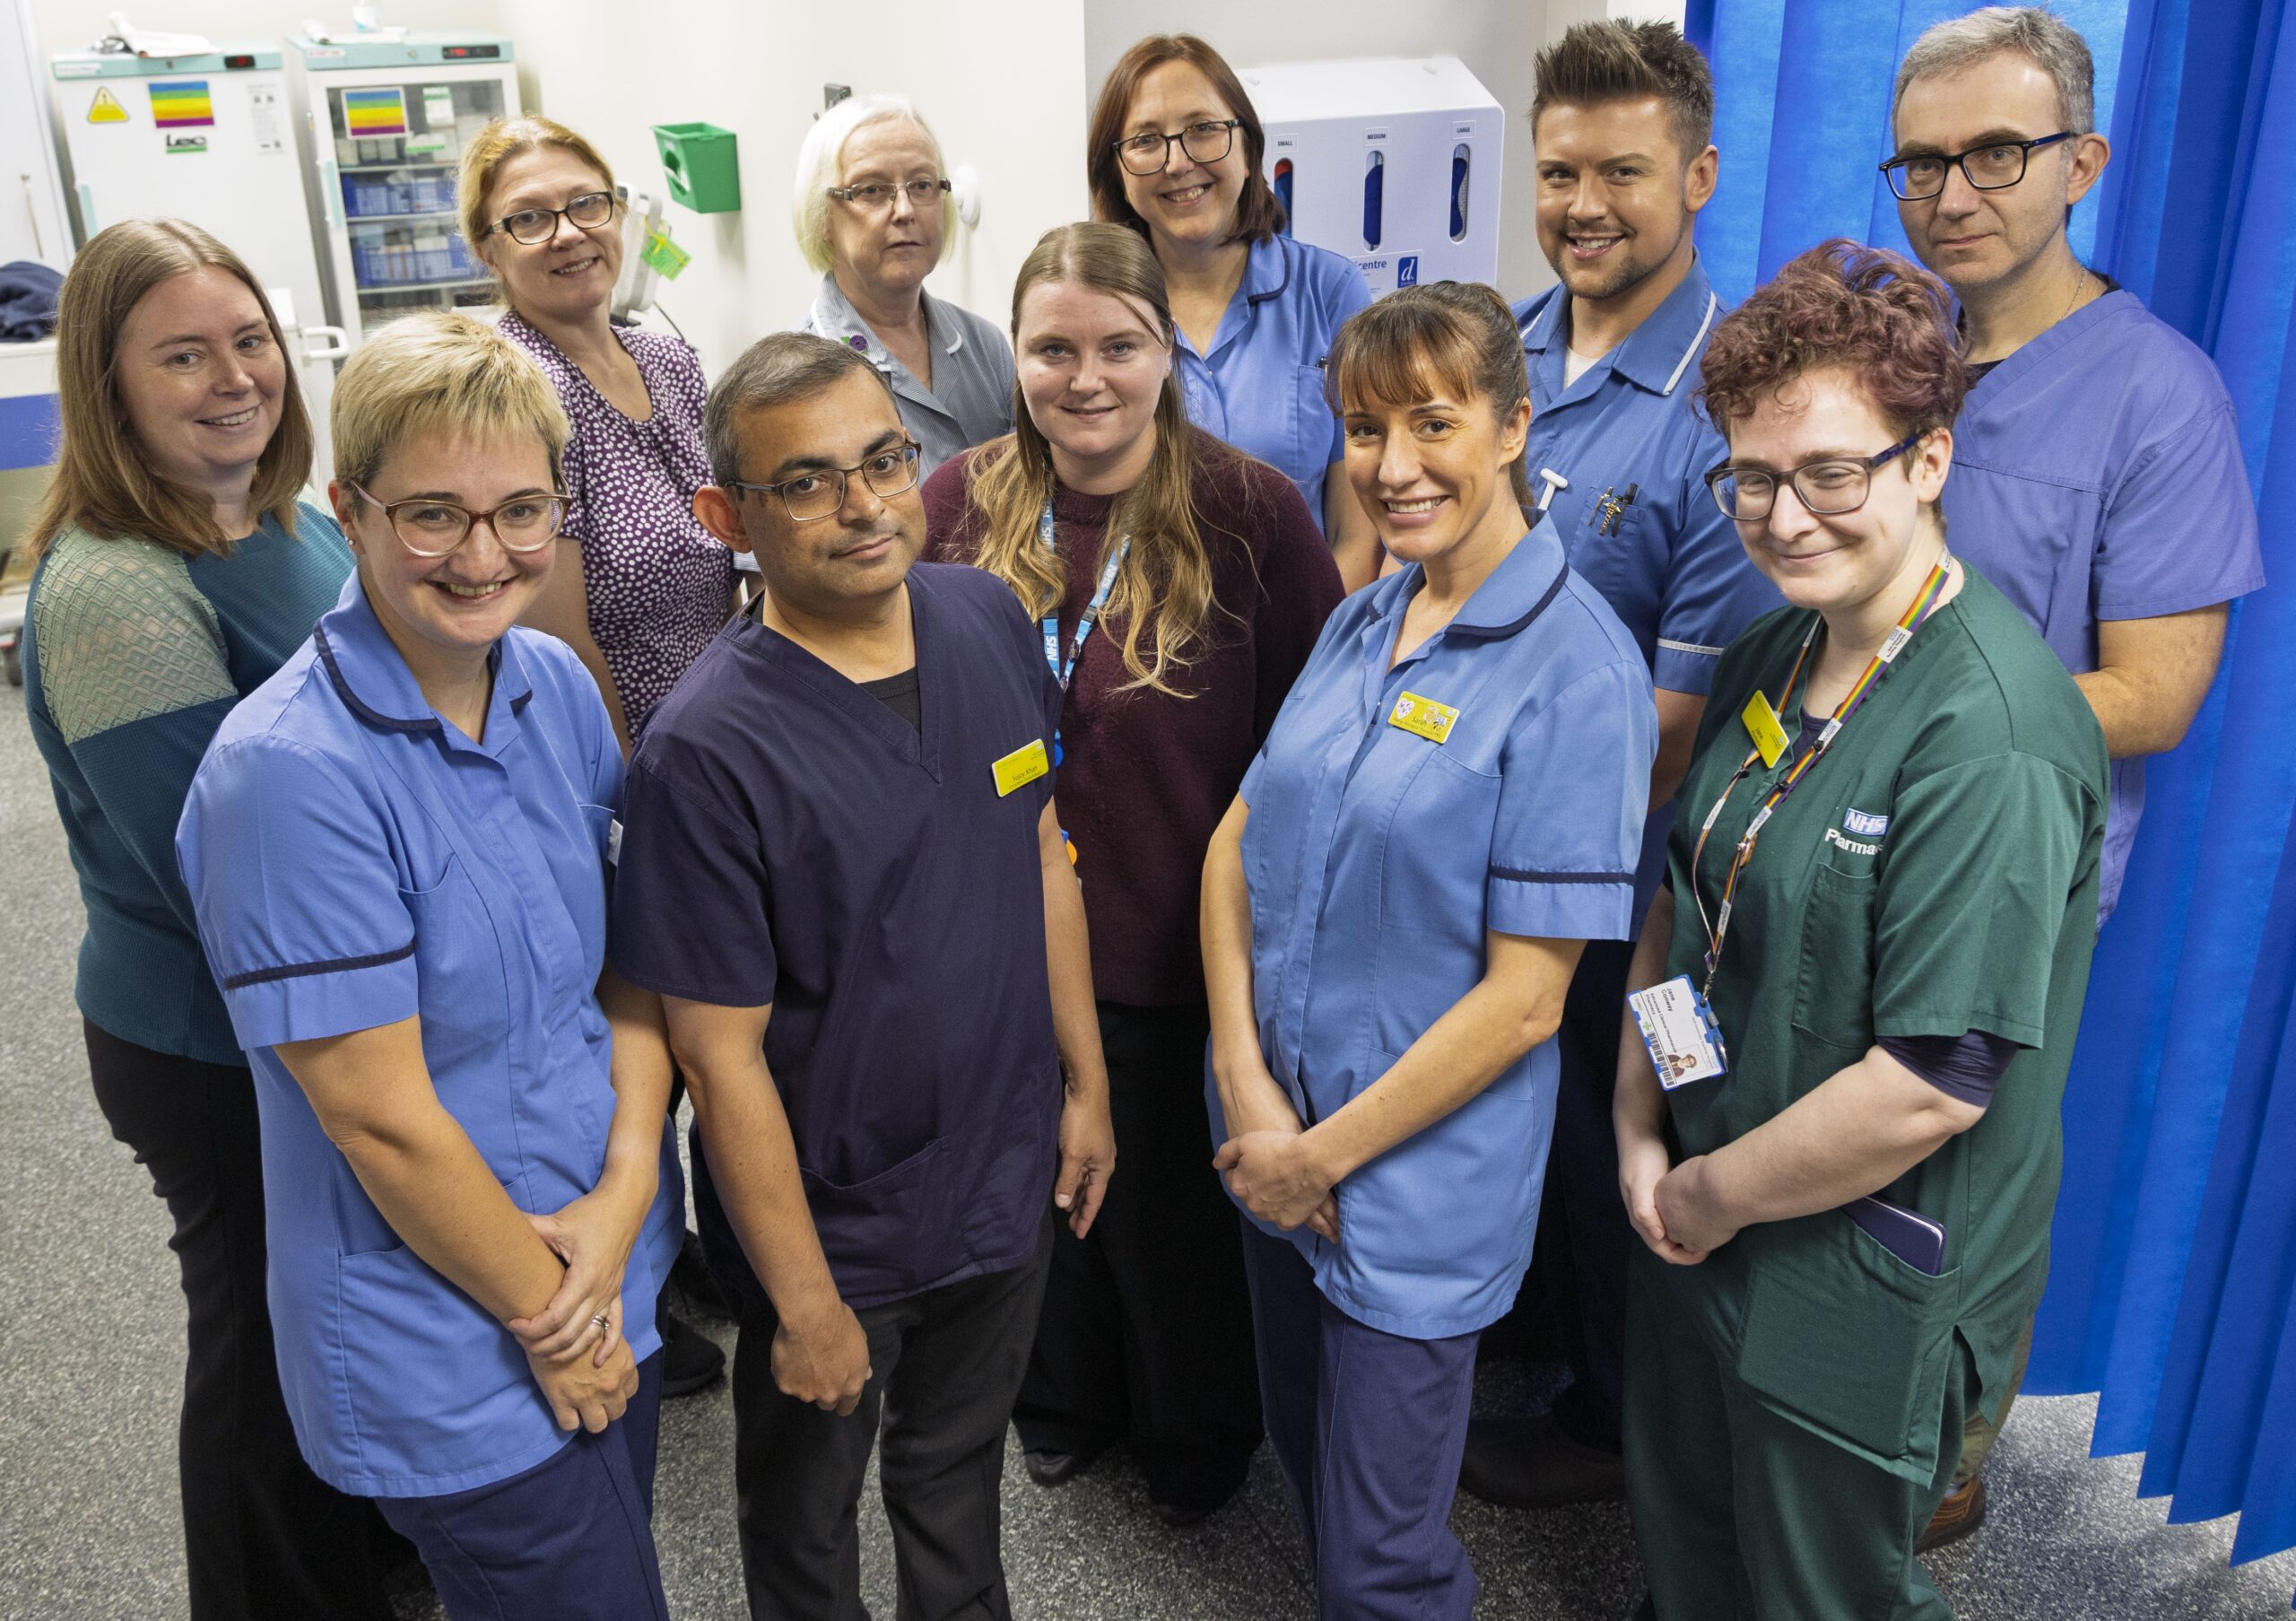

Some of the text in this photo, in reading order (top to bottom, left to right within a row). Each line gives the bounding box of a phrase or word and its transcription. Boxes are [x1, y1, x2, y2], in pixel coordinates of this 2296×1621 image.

[166, 134, 207, 147] Lec
[1355, 259, 1387, 271] centre
[1102, 562, 1118, 590] NHS
[1046, 635, 1058, 661] NHS
[1012, 772, 1025, 782] Sujoy
[1025, 766, 1038, 775] Khan
[1846, 811, 1887, 834] NHS
[1661, 989, 1673, 1012] Conway
[1666, 988, 1675, 1001] Jane
